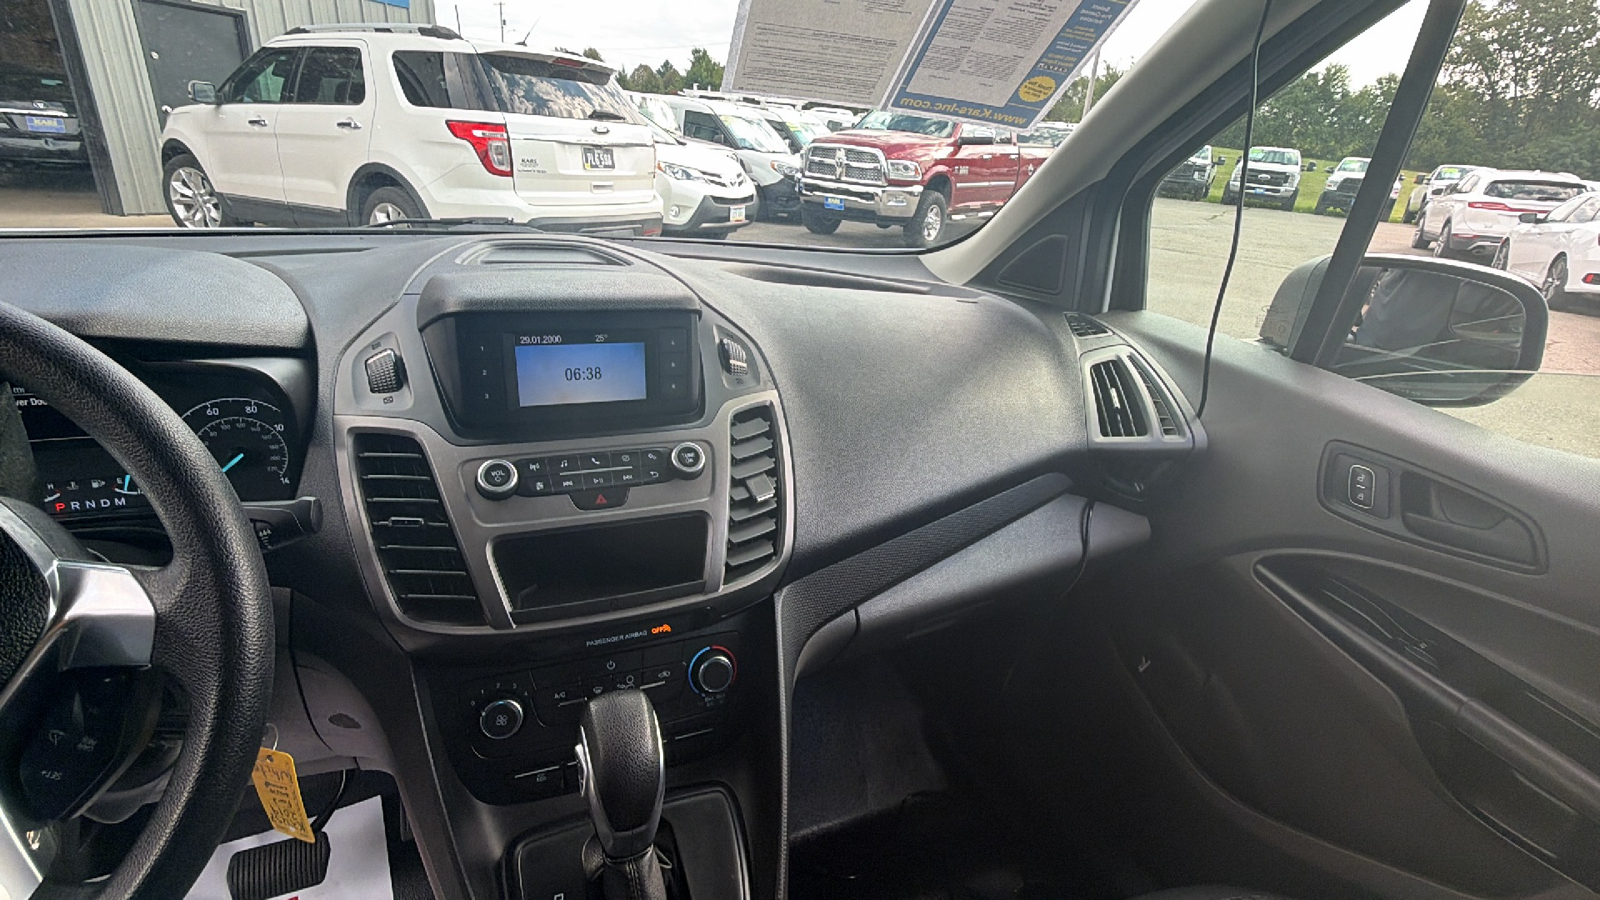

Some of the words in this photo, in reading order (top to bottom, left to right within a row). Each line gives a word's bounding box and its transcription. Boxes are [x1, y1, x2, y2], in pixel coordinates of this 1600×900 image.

[520, 335, 562, 344] 29.01.2000
[564, 366, 602, 381] 06:38
[206, 407, 219, 416] 60
[245, 405, 258, 414] 80
[491, 469, 506, 477] VOL
[55, 502, 66, 511] P
[70, 501, 81, 510] R
[85, 500, 96, 509] N
[100, 499, 111, 508] D
[114, 497, 126, 506] M
[586, 634, 624, 647] PASSENGER
[624, 630, 647, 640] AIRBAG
[554, 691, 566, 699] A/C
